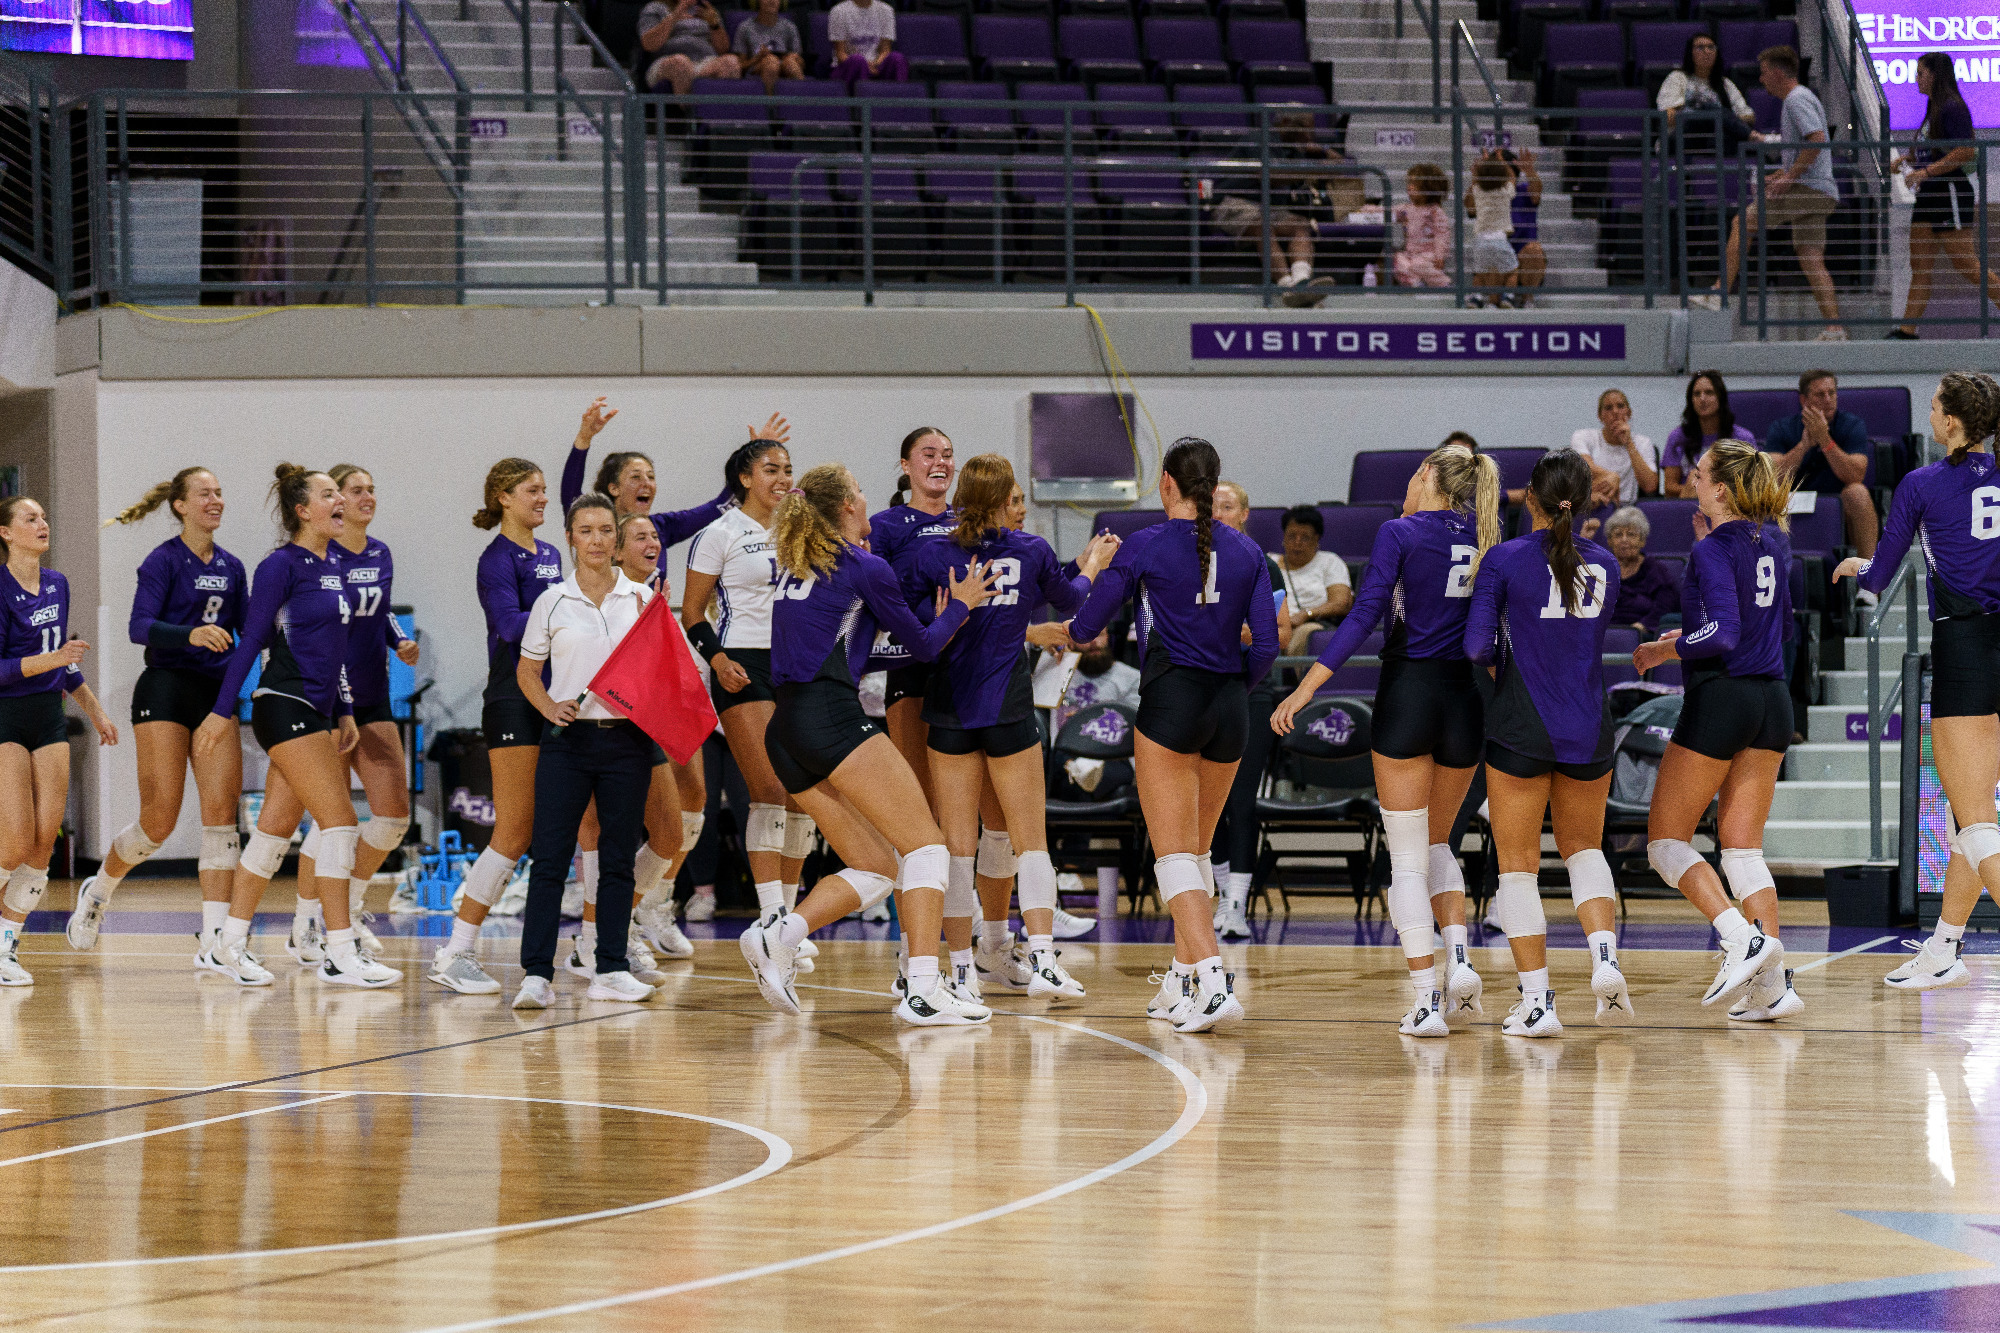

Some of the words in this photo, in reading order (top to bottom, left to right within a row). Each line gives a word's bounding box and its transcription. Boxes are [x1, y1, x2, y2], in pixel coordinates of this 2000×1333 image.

[1214, 331, 1389, 352] VISITOR
[1417, 331, 1601, 353] SECTION
[1971, 486, 2000, 540] 6
[198, 577, 227, 589] ACU
[350, 569, 378, 582] ACU
[1195, 551, 1220, 604] 1
[1444, 545, 1479, 598] 2
[1755, 555, 1776, 608] 9
[354, 586, 383, 617] 17
[1540, 563, 1607, 619] 10
[33, 607, 59, 623] ACU
[202, 595, 224, 624] 8
[338, 594, 351, 624] 4
[40, 626, 61, 654] 11
[872, 645, 909, 655] DCAT
[1086, 720, 1122, 742] ACU
[1311, 720, 1349, 743] ACU
[451, 790, 496, 823] ACU
